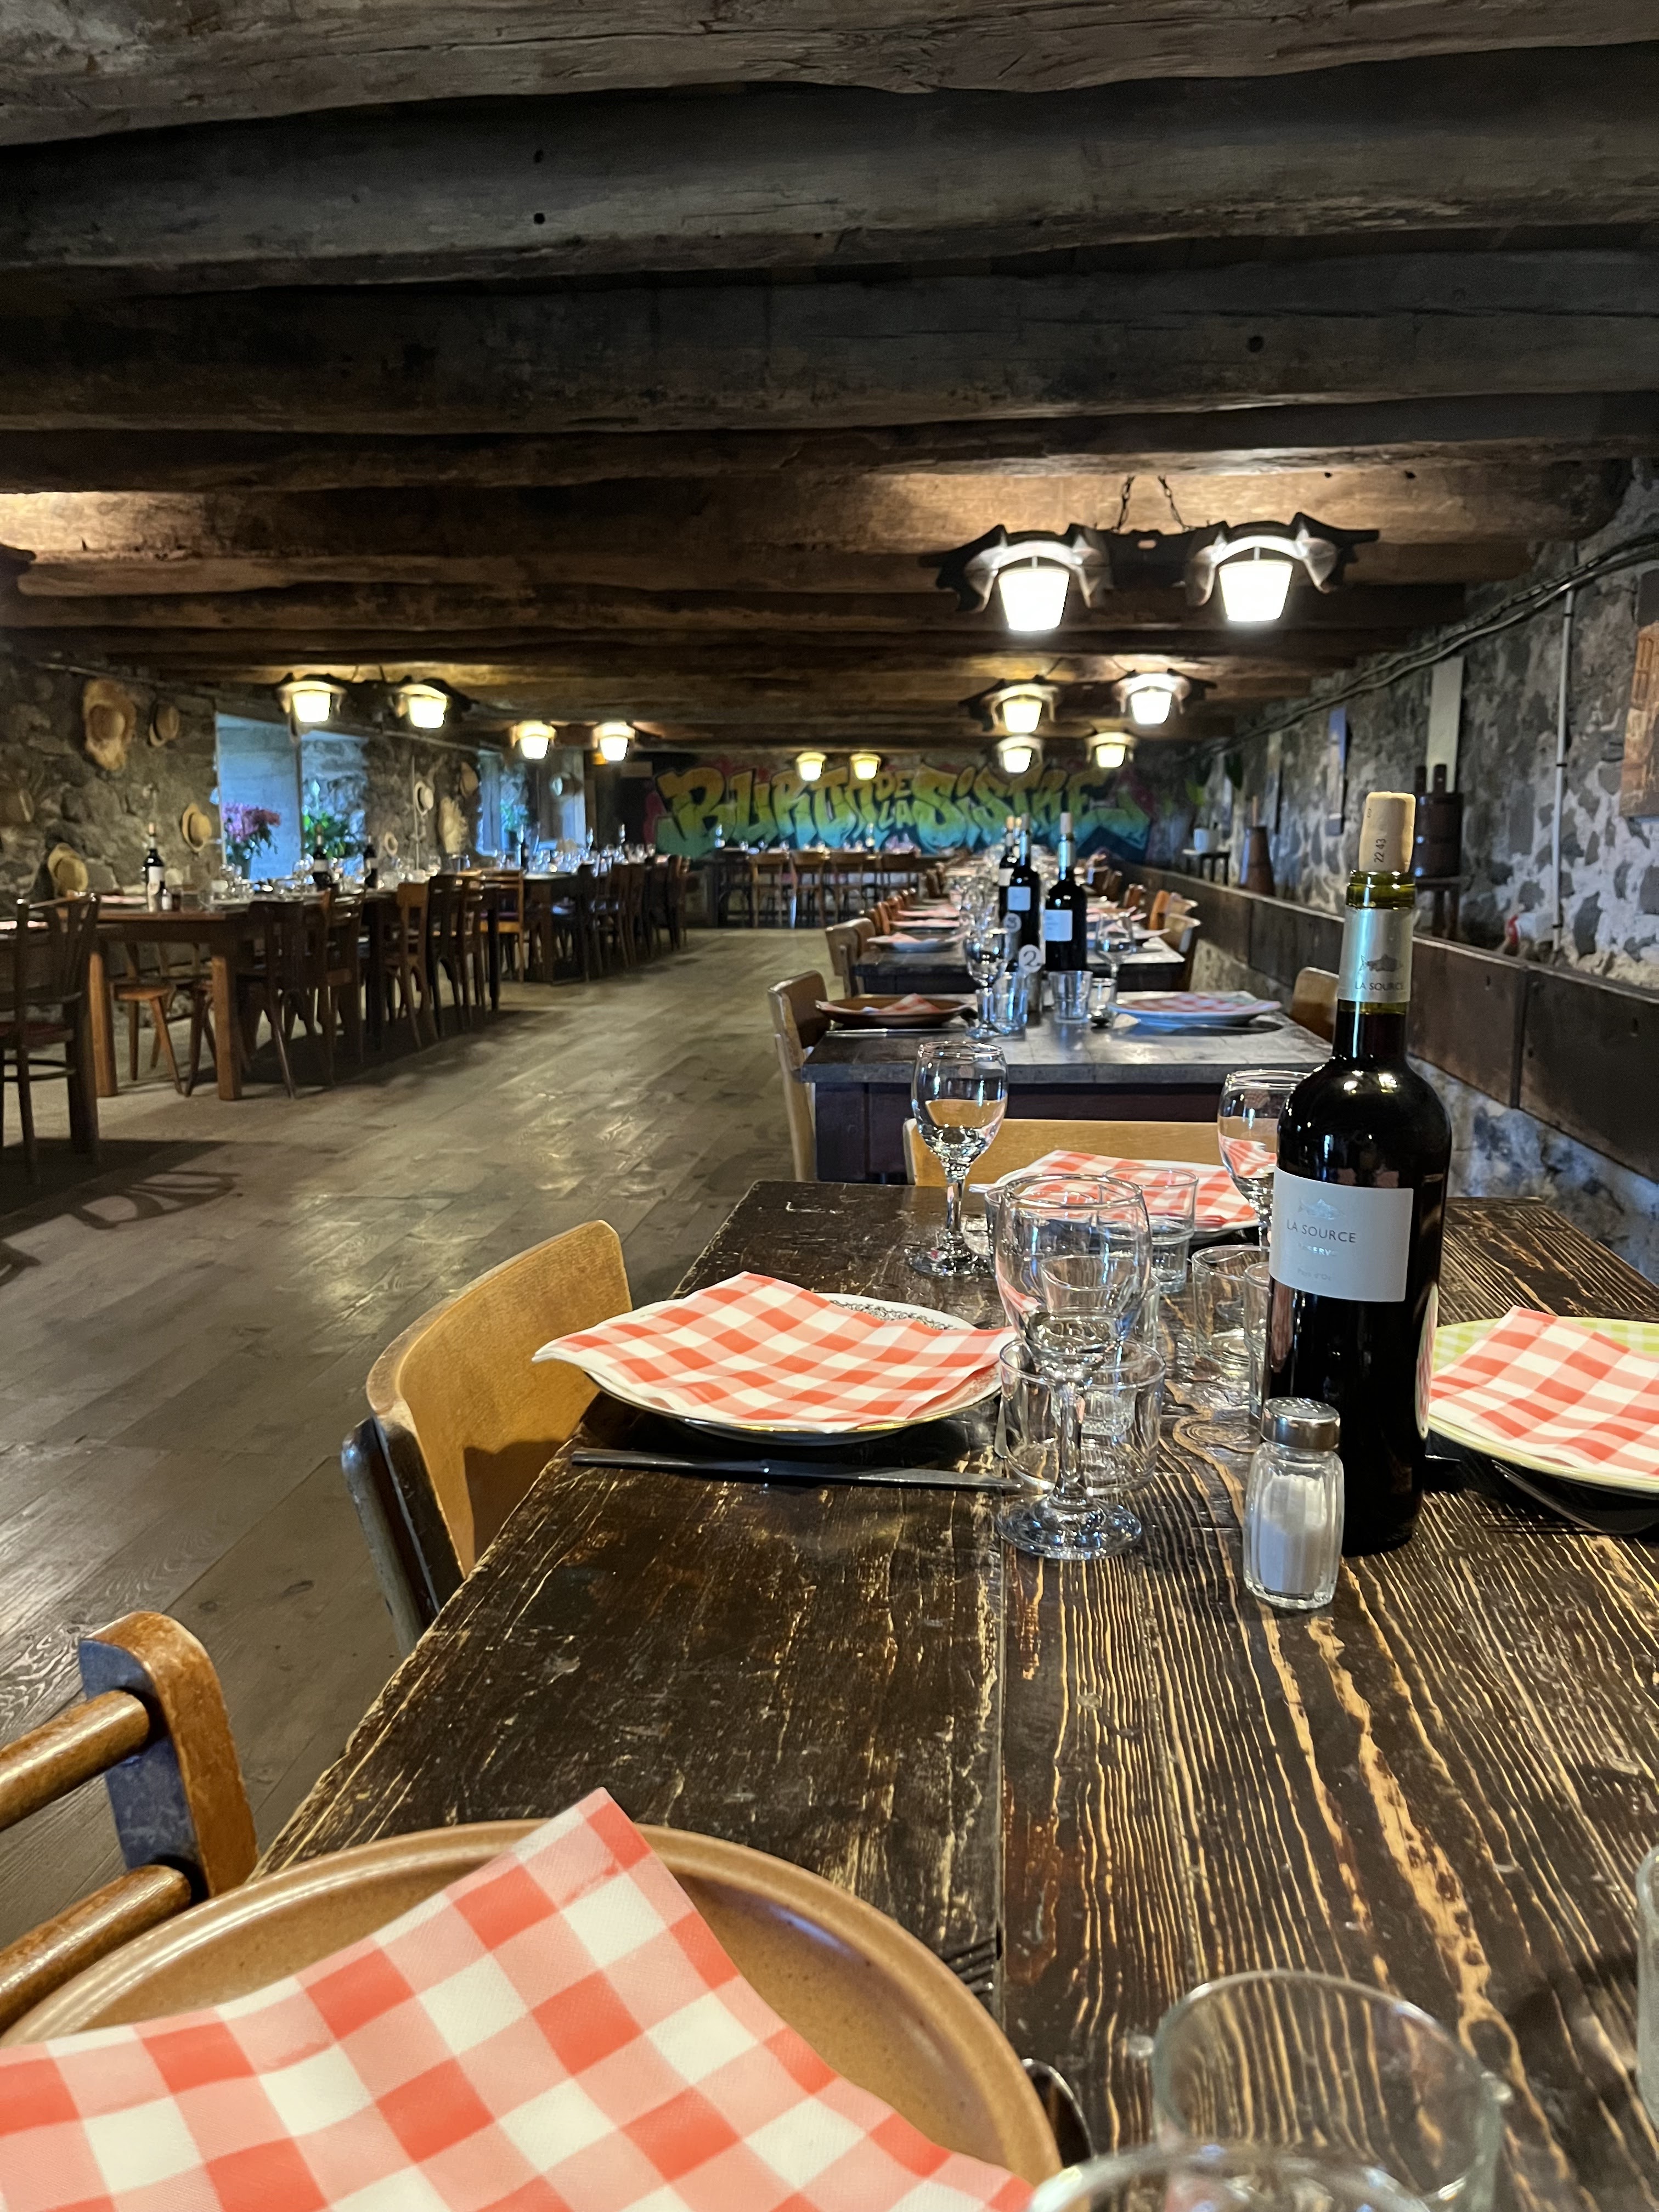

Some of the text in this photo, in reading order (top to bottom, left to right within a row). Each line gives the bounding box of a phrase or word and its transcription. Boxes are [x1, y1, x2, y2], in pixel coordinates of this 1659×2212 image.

[876, 769, 915, 802] DE
[878, 799, 913, 829] LA
[1023, 950, 1041, 967] 2
[1355, 980, 1367, 990] LA
[1286, 1219, 1357, 1243] LA SOURCE
